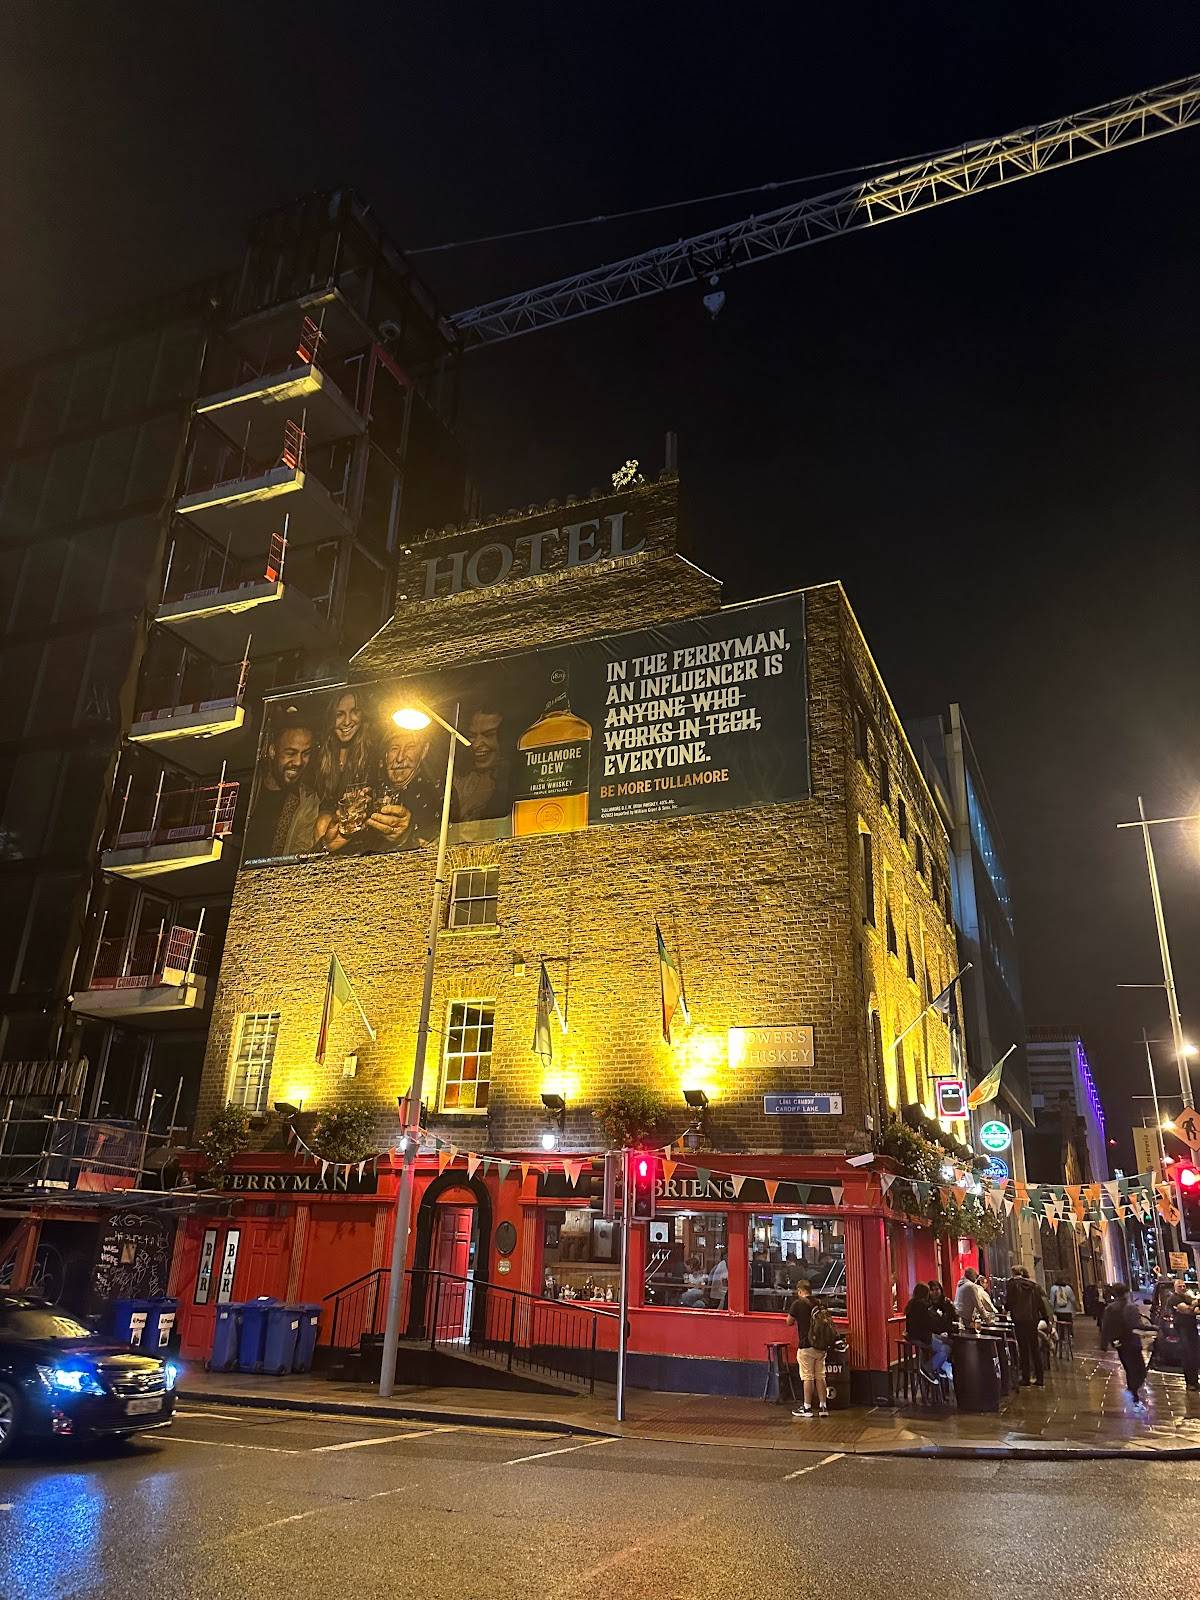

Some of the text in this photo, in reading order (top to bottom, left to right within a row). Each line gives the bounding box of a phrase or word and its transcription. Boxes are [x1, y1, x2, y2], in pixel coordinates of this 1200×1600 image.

[422, 512, 646, 599] HOTEL
[606, 629, 791, 682] IN THE FERRYMAN,
[605, 654, 783, 705] AN INFLUENCER IS
[604, 687, 742, 728] ANYONE WHO
[604, 708, 762, 752] WORKS IN TECH,
[525, 747, 582, 766] TULLAMORE
[541, 762, 564, 775] DEW
[603, 741, 712, 777] EVERYONE.
[530, 780, 573, 791] IRISH WHISKEY
[600, 769, 729, 798] BE MORE TULLAMORE
[744, 1030, 807, 1044] OWER'S
[743, 1049, 810, 1063] HISKEY
[833, 1101, 839, 1110] 2
[223, 1174, 348, 1191] FERRYMAN
[199, 1242, 214, 1292] BAR
[222, 1243, 236, 1293] BAR
[824, 1365, 843, 1374] ADDY
